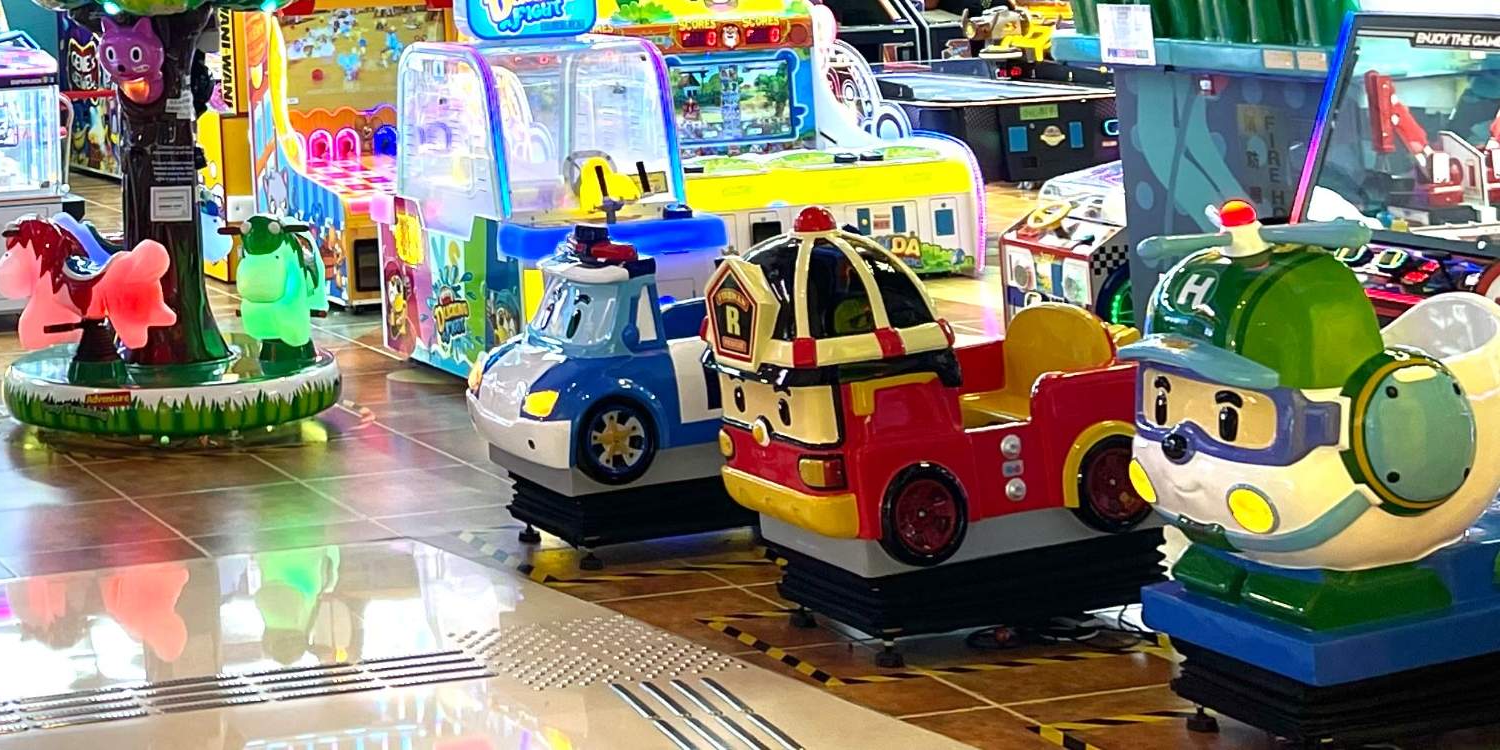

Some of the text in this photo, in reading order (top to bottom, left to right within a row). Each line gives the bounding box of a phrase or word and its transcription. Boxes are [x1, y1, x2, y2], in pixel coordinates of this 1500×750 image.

[678, 18, 717, 31] SCORES
[742, 16, 780, 28] SCORES
[1416, 32, 1449, 45] ENJOY
[1451, 34, 1472, 46] THE
[1177, 274, 1215, 309] H
[725, 304, 741, 336] R
